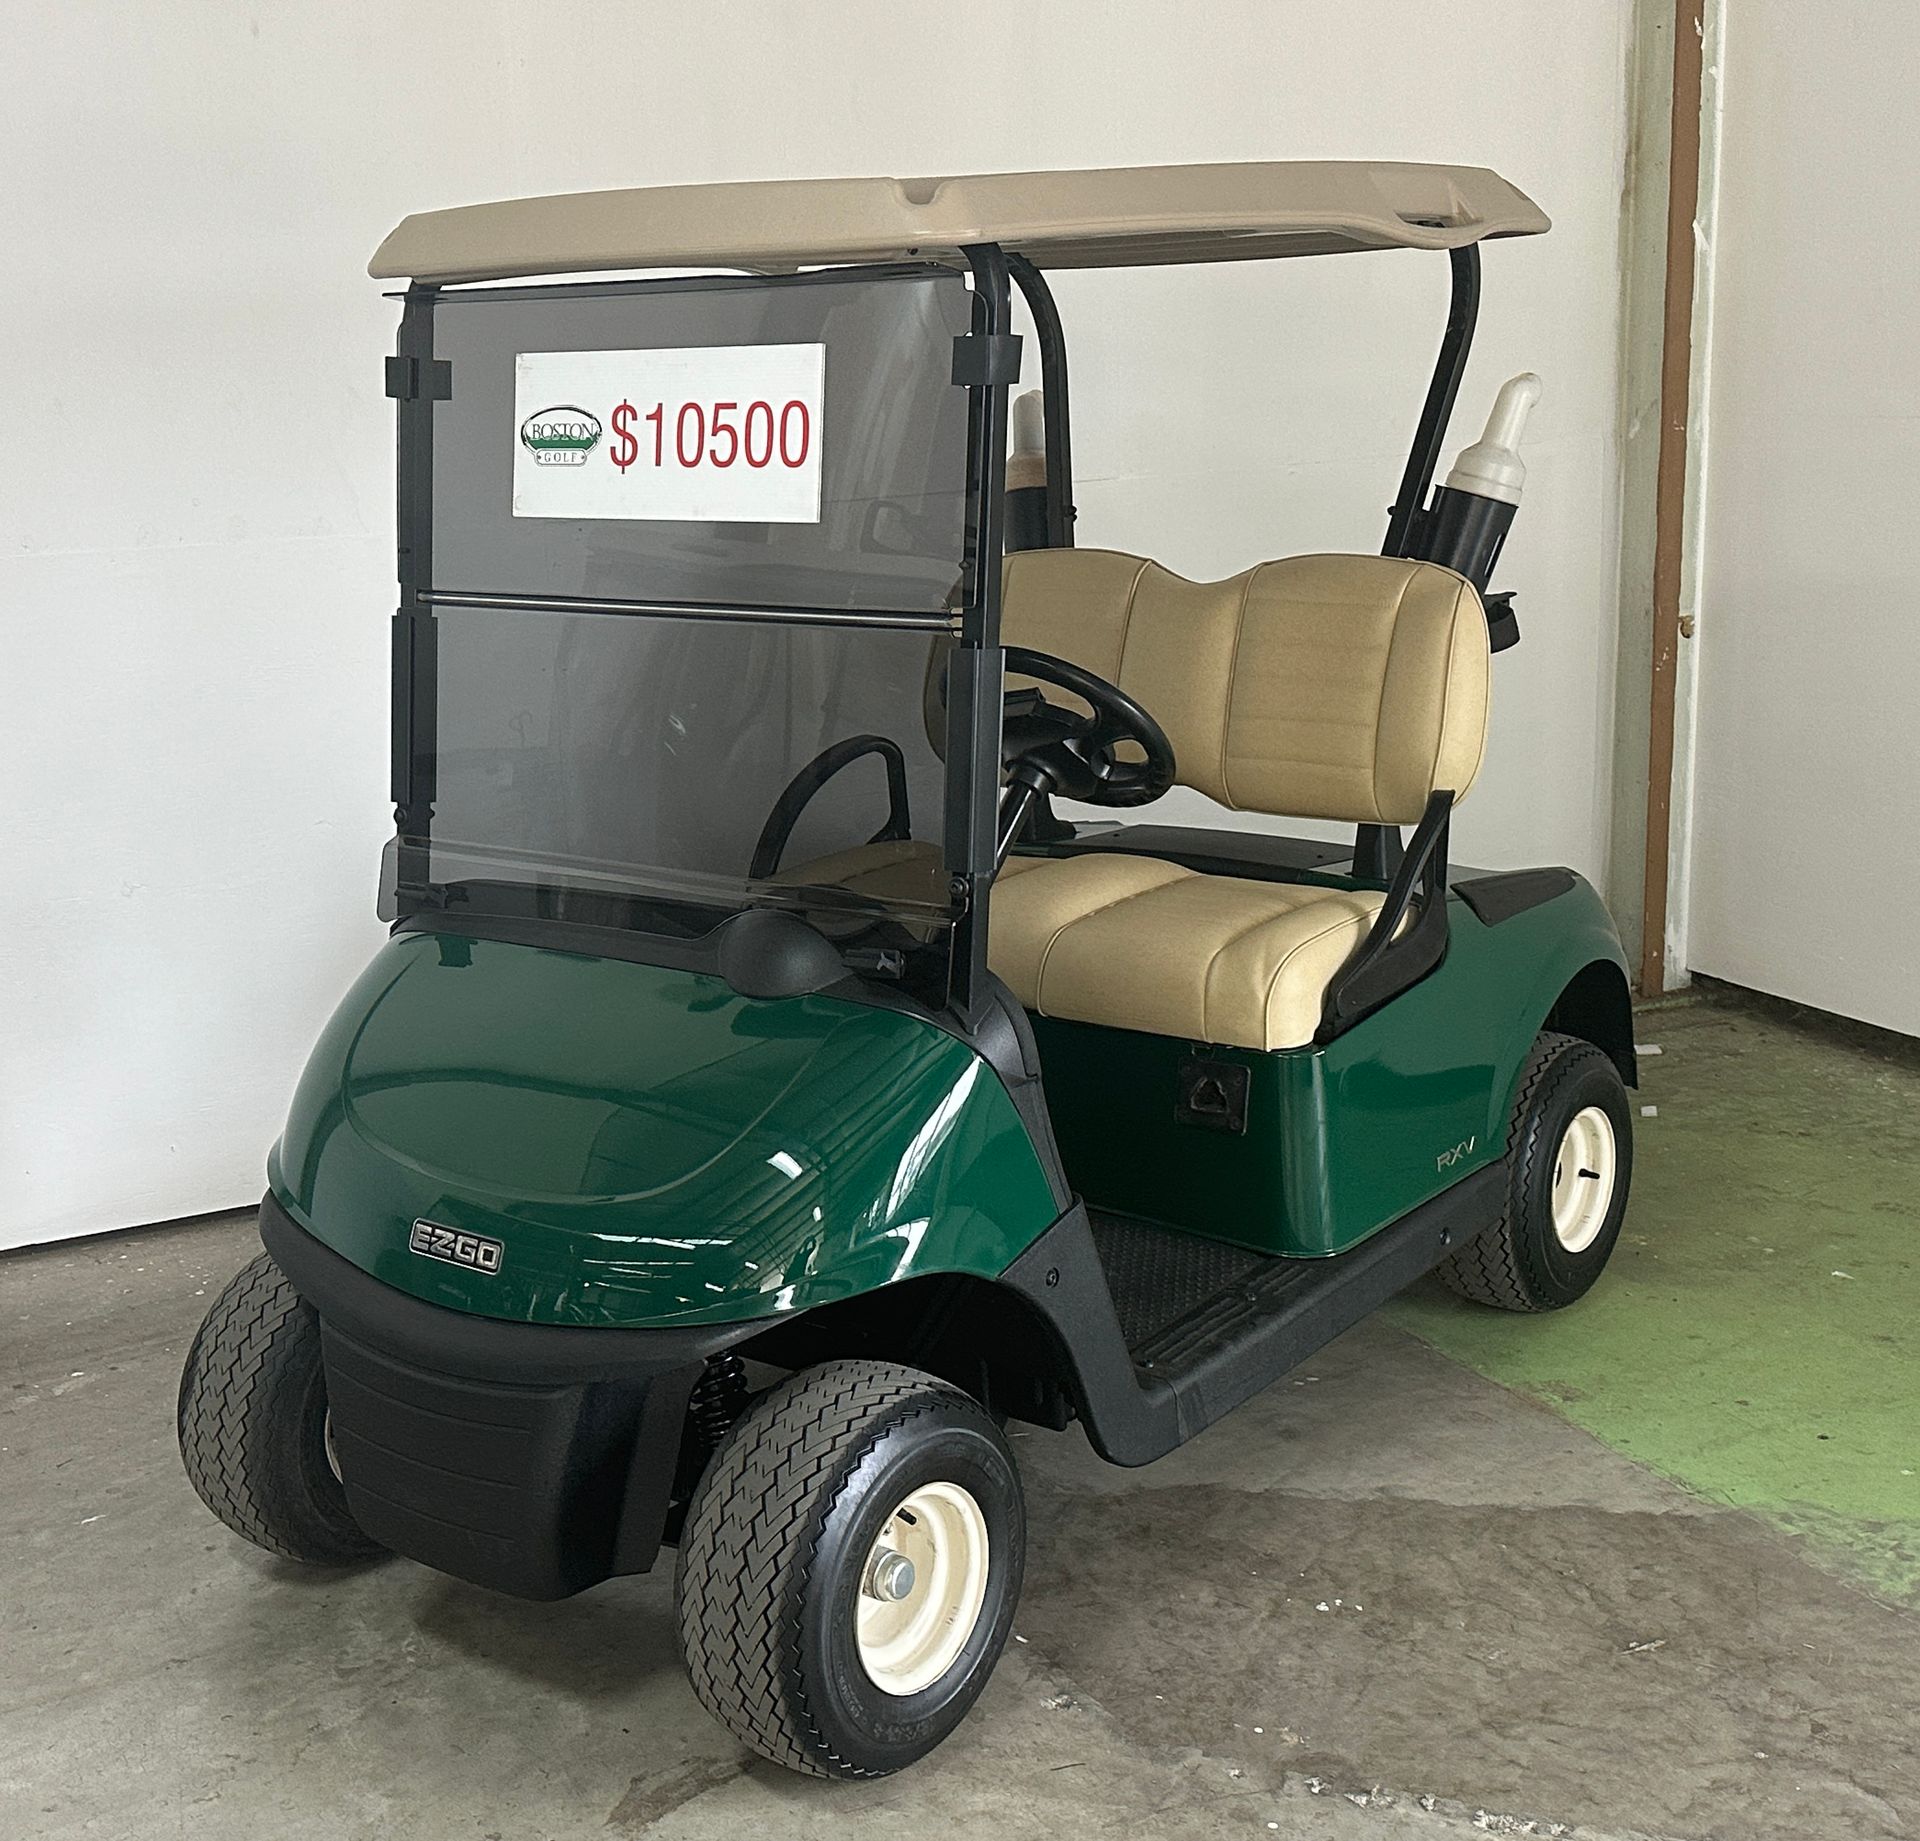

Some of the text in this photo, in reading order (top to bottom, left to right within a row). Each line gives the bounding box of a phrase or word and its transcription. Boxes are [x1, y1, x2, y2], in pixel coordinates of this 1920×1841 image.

[532, 423, 595, 441] BOSTON
[610, 399, 810, 475] $10500
[544, 452, 577, 463] GOLF
[1436, 1135, 1475, 1173] RXV
